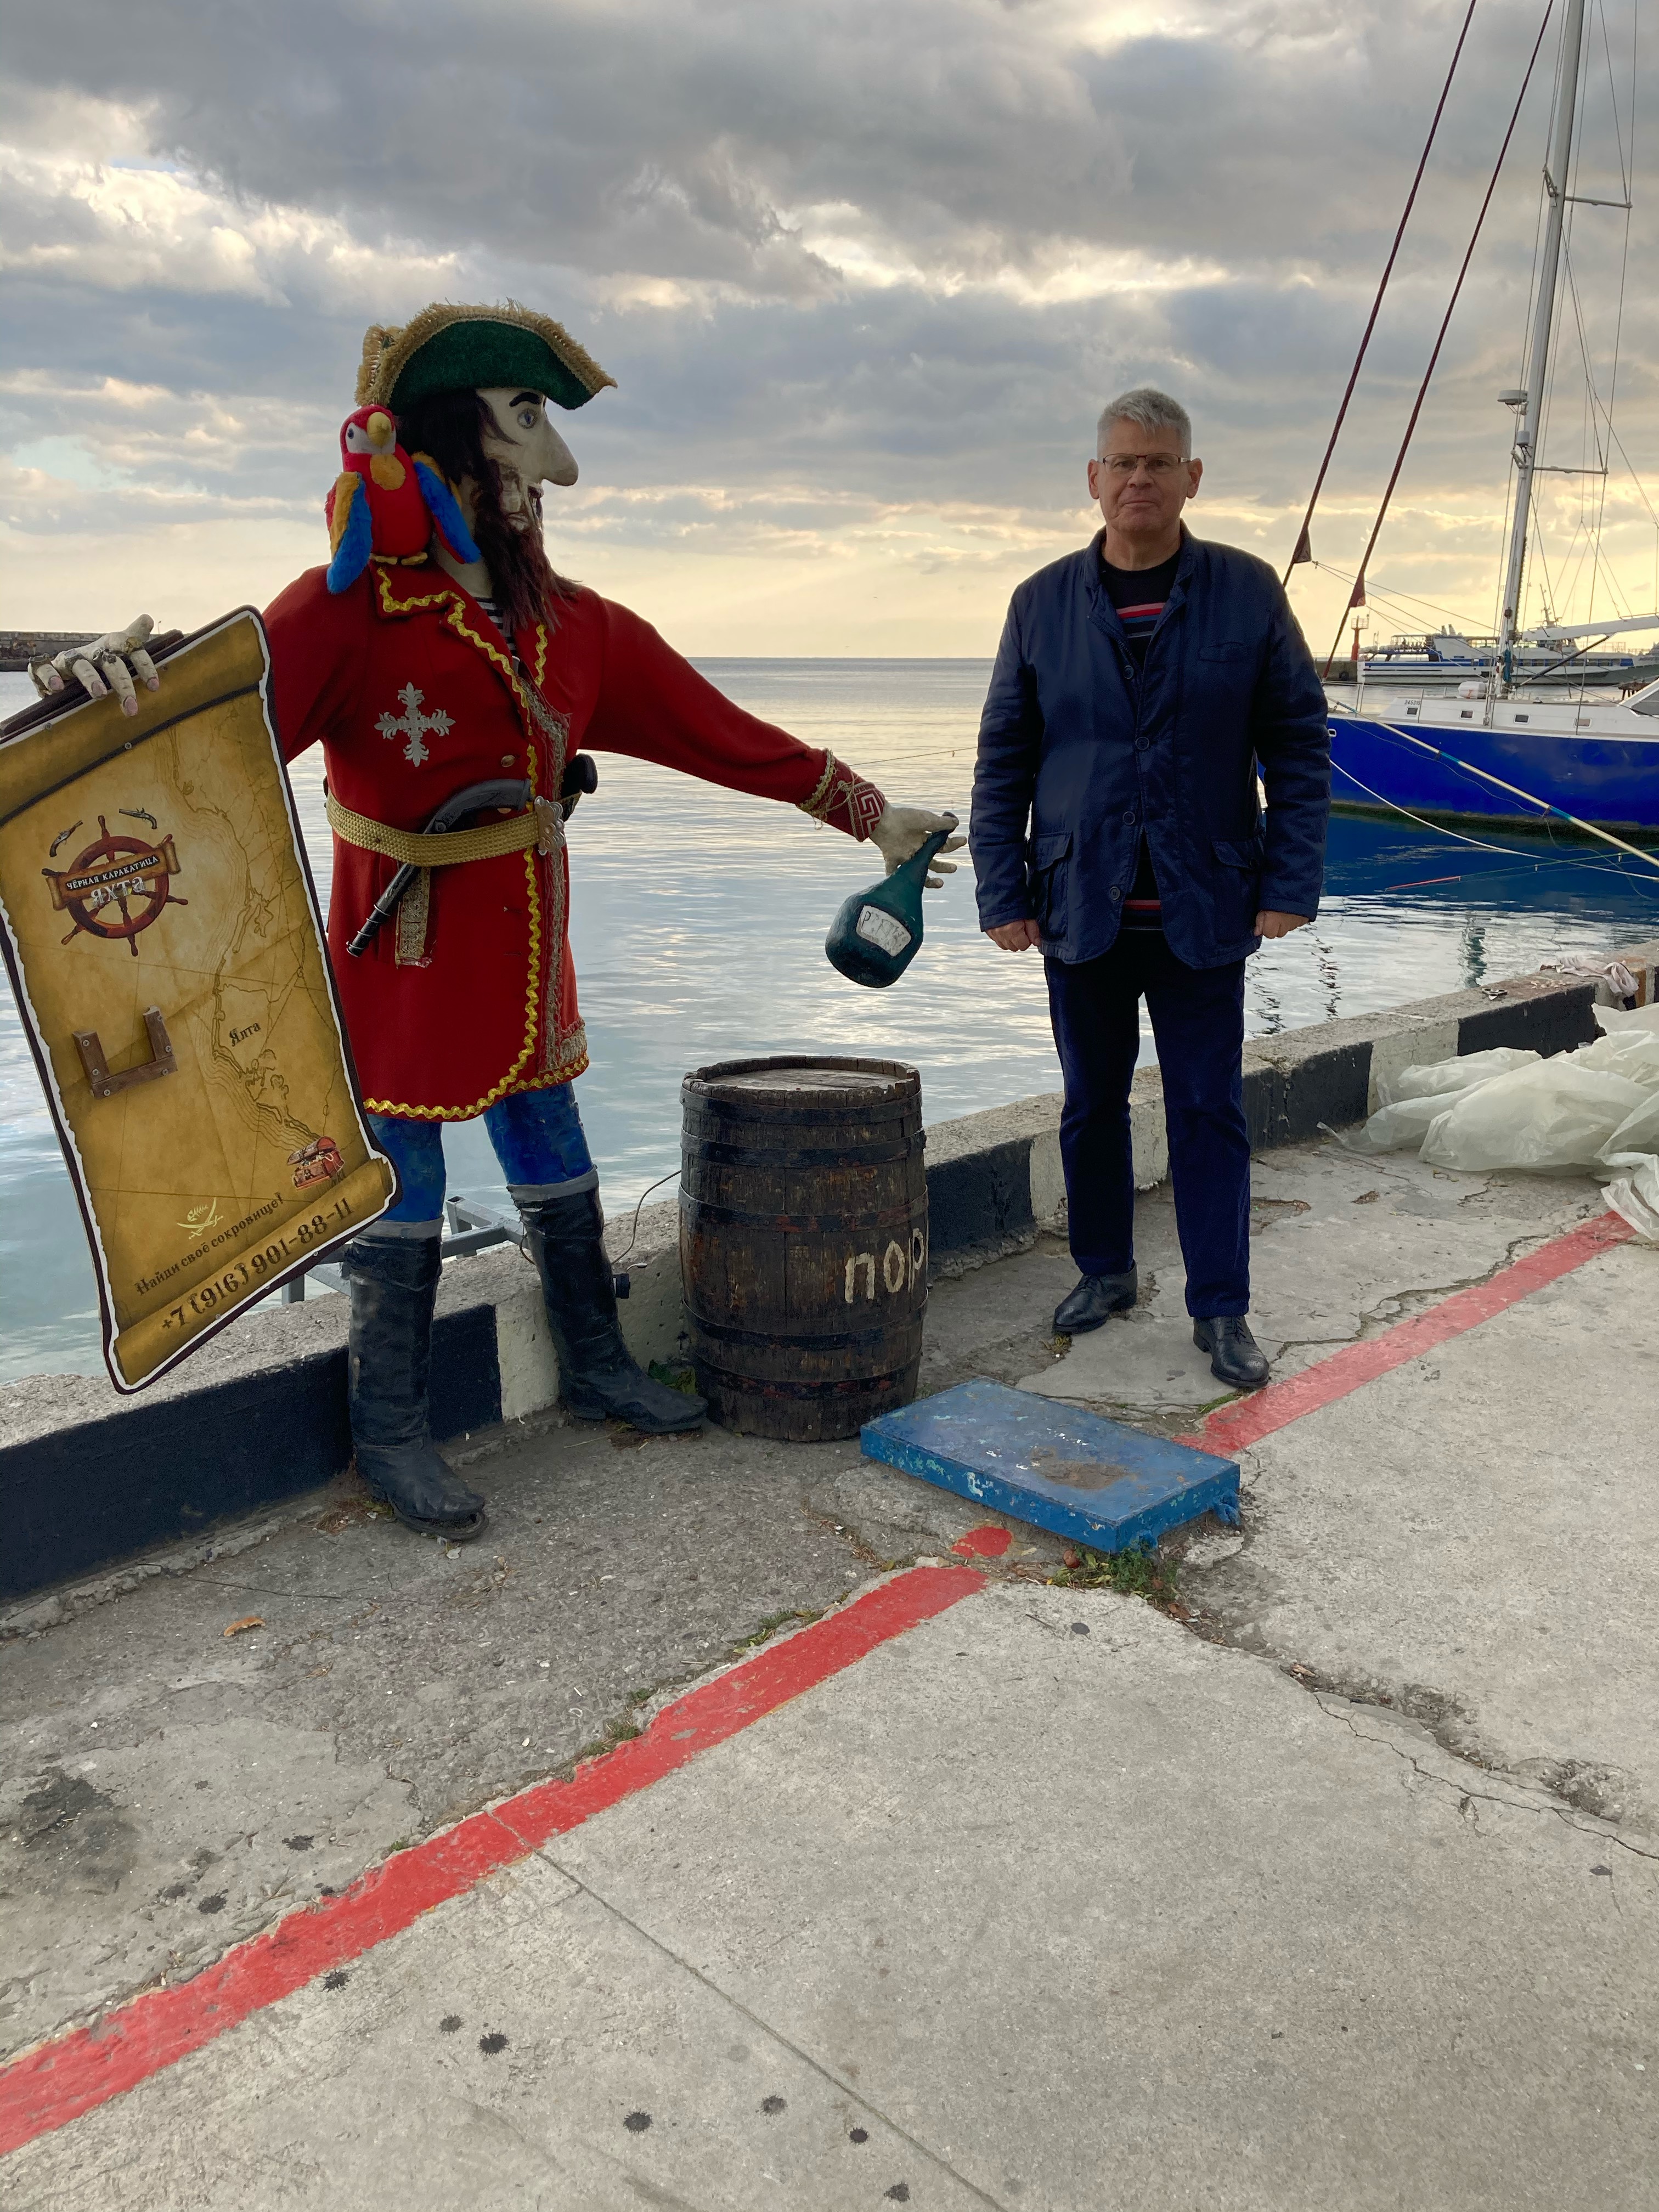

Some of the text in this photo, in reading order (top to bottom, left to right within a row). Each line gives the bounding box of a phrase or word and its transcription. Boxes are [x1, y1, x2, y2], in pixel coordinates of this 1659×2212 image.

[66, 856, 159, 890] ЧЁРНАЯ КАРАКАТИЦА
[229, 1023, 261, 1047] Ялта
[134, 1192, 283, 1296] Найди своё сокровище!
[162, 1197, 353, 1329] +7 (916) 901-88-11
